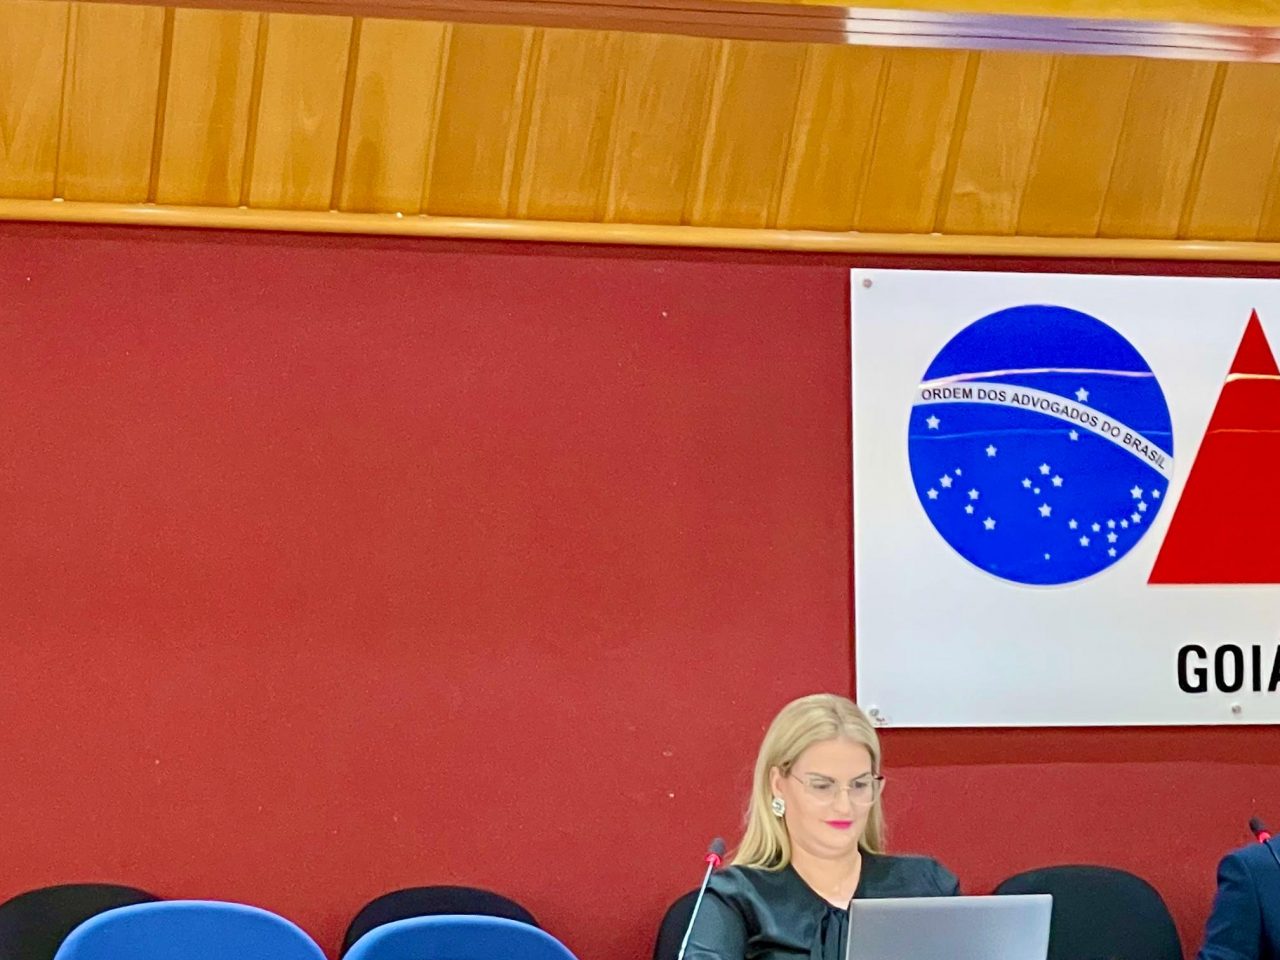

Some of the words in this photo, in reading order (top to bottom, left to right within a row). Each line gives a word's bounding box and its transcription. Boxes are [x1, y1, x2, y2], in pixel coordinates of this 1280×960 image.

[921, 387, 973, 401] ORDEM
[977, 388, 1007, 402] DOS
[1011, 392, 1099, 428] ADVOGADOS
[1101, 420, 1121, 438] DO
[1122, 432, 1165, 470] BRASIL
